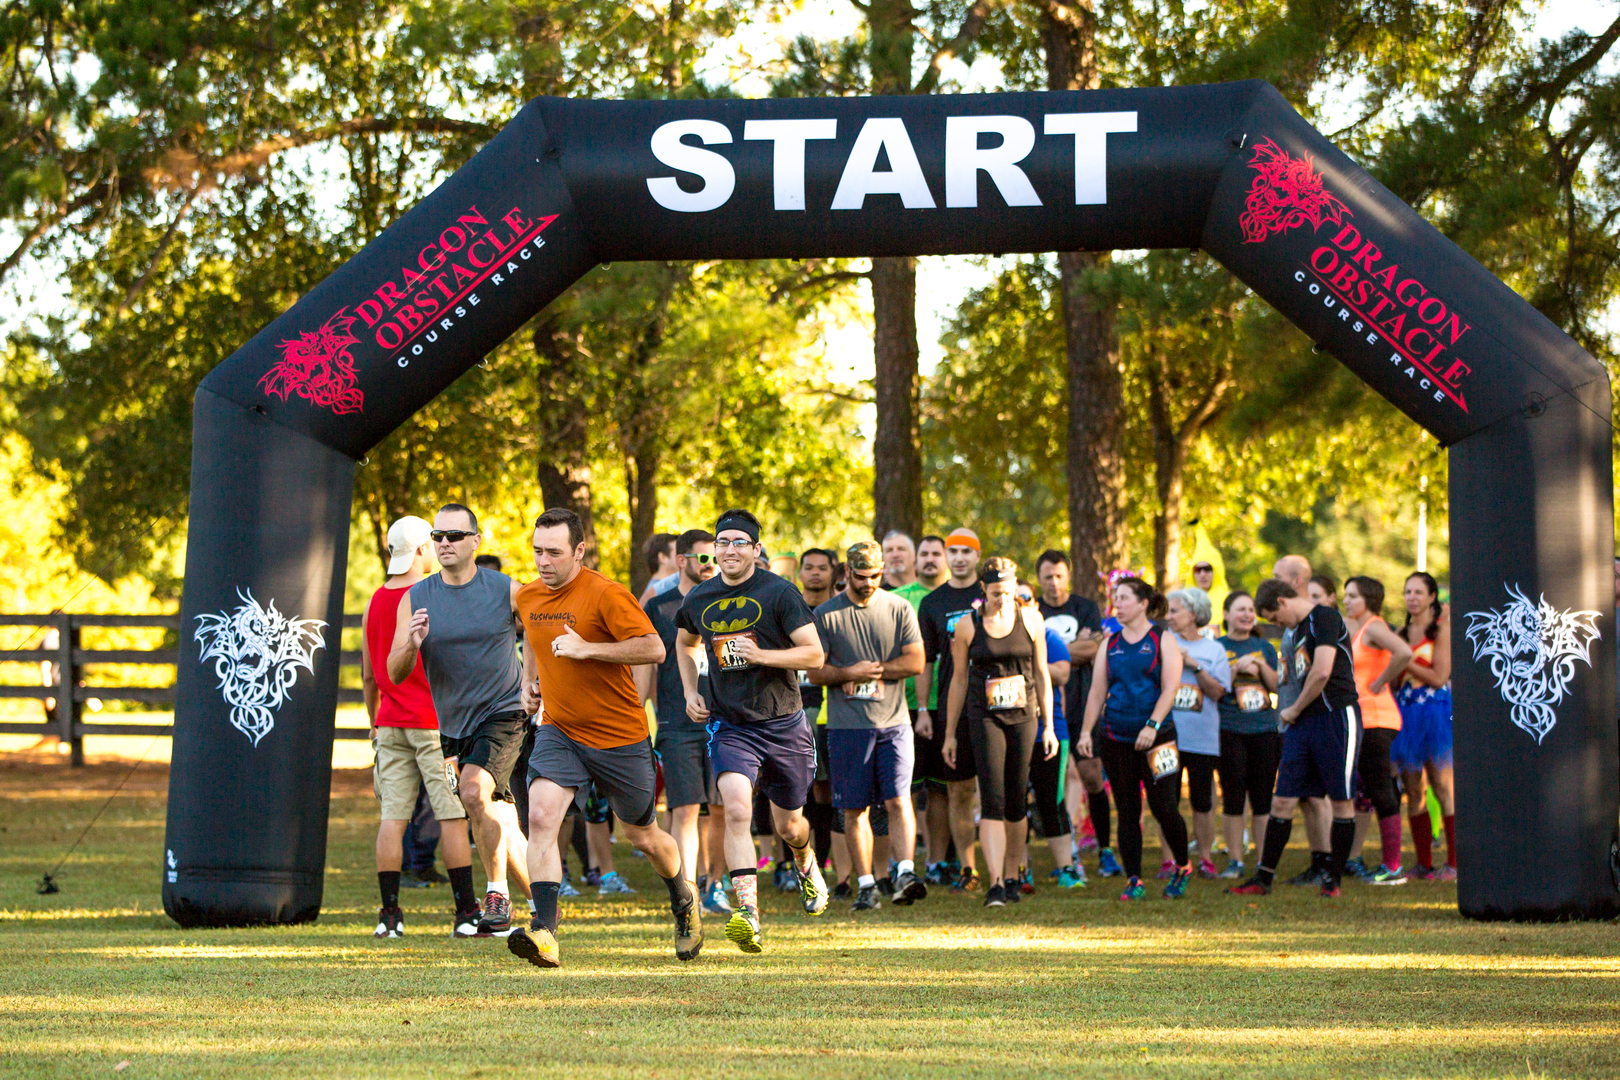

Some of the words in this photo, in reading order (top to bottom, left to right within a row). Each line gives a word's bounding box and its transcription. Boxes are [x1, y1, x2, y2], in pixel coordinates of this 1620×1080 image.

[646, 111, 1138, 213] START
[353, 205, 489, 329] DRAGON
[376, 207, 534, 349] OBSTACLE
[397, 293, 481, 368] COURSE
[491, 235, 546, 286] RACE
[1310, 246, 1472, 389] OBSTACLE
[1329, 221, 1472, 345] DRAGON
[1294, 270, 1378, 345] COURSE
[1390, 352, 1445, 402] RACE
